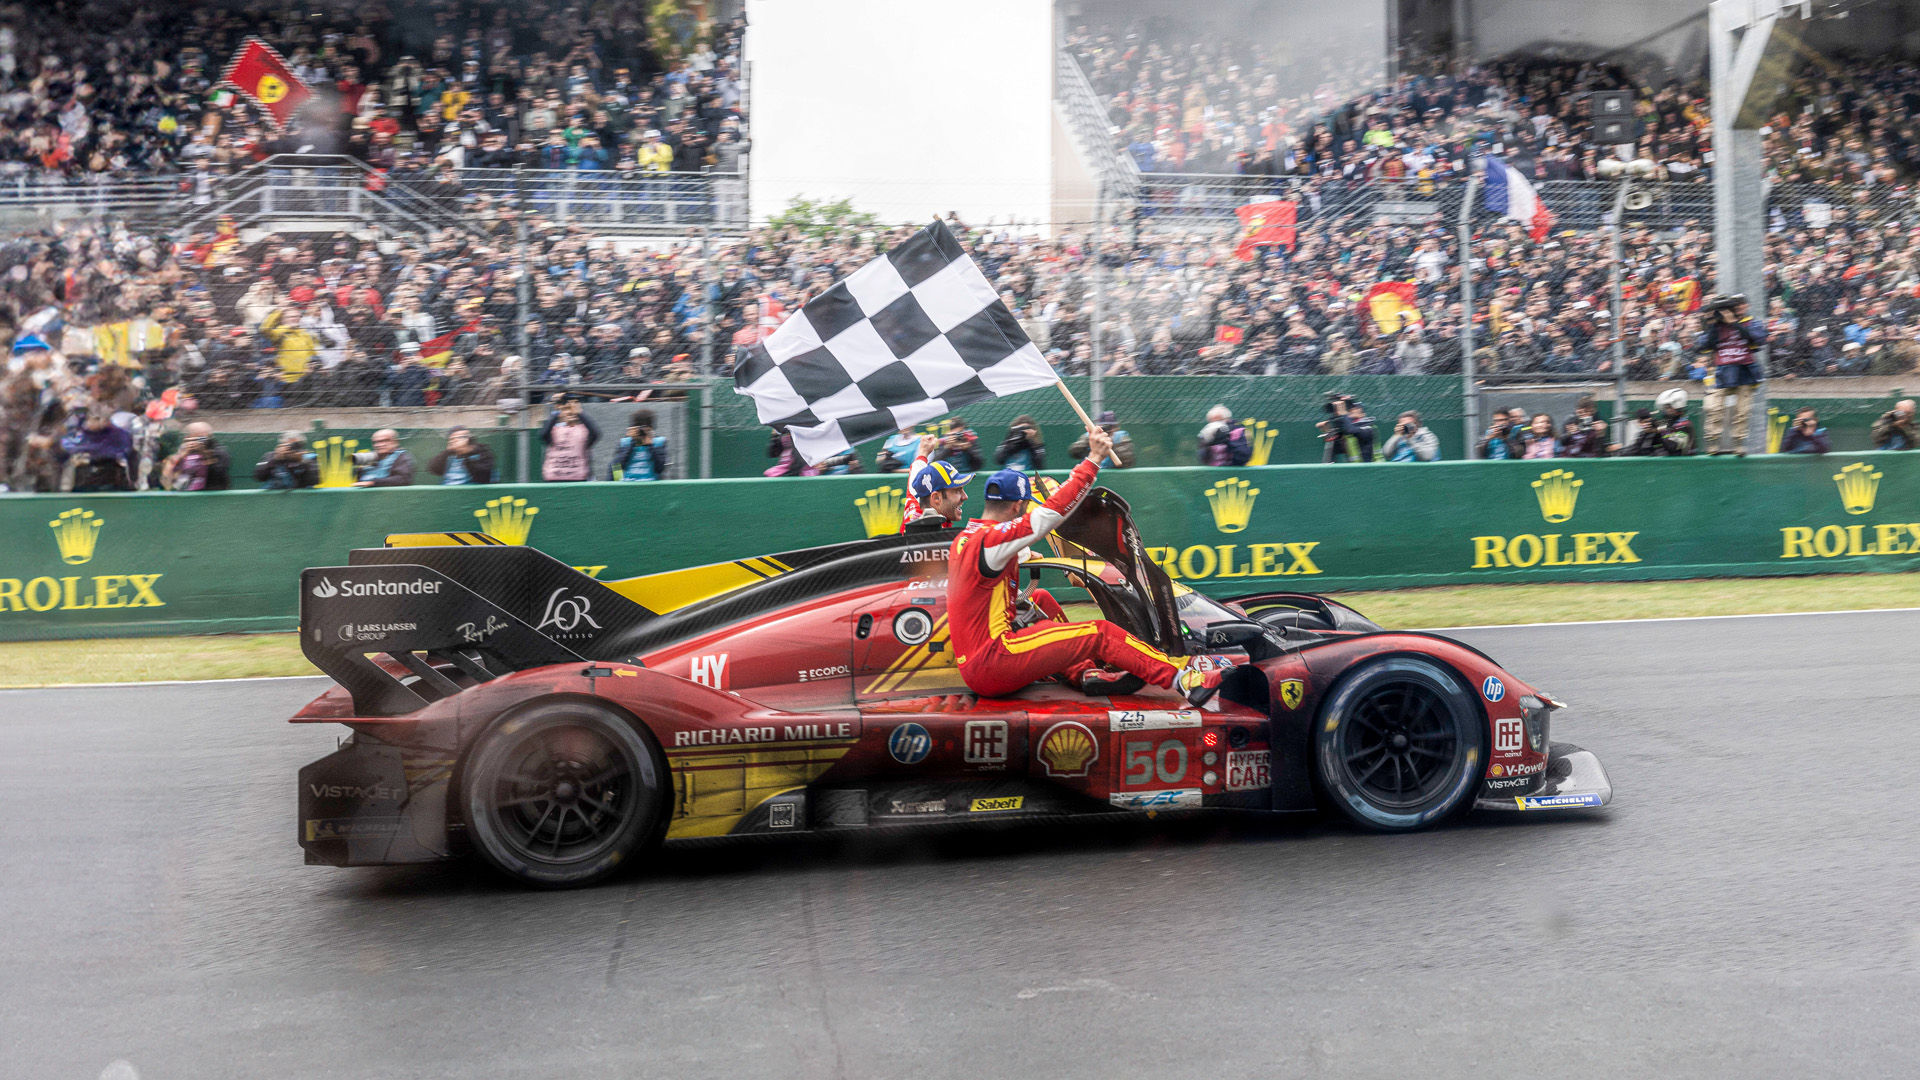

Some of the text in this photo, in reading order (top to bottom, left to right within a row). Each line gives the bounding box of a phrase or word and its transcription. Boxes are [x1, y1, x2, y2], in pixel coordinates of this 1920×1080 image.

[900, 549, 949, 563] ADLER
[1145, 541, 1323, 579] ROLEX
[1471, 531, 1642, 569] ROLEX
[0, 574, 167, 612] ROLEX
[341, 578, 443, 597] Santander
[357, 622, 417, 632] LARS LARSEN
[357, 632, 387, 641] GROUP
[456, 615, 509, 643] Ray-Ban
[690, 653, 728, 690] HY
[809, 664, 850, 678] ECOPOL
[1486, 676, 1502, 702] hp
[675, 723, 851, 746] RICHARD MILLE
[895, 723, 926, 763] hp
[1125, 739, 1189, 785] 50
[1229, 752, 1270, 767] HYPER
[1506, 762, 1544, 777] V-Power
[1229, 765, 1270, 787] CAR
[976, 798, 1018, 810] Sabelt
[1541, 796, 1593, 805] MICHELIN
